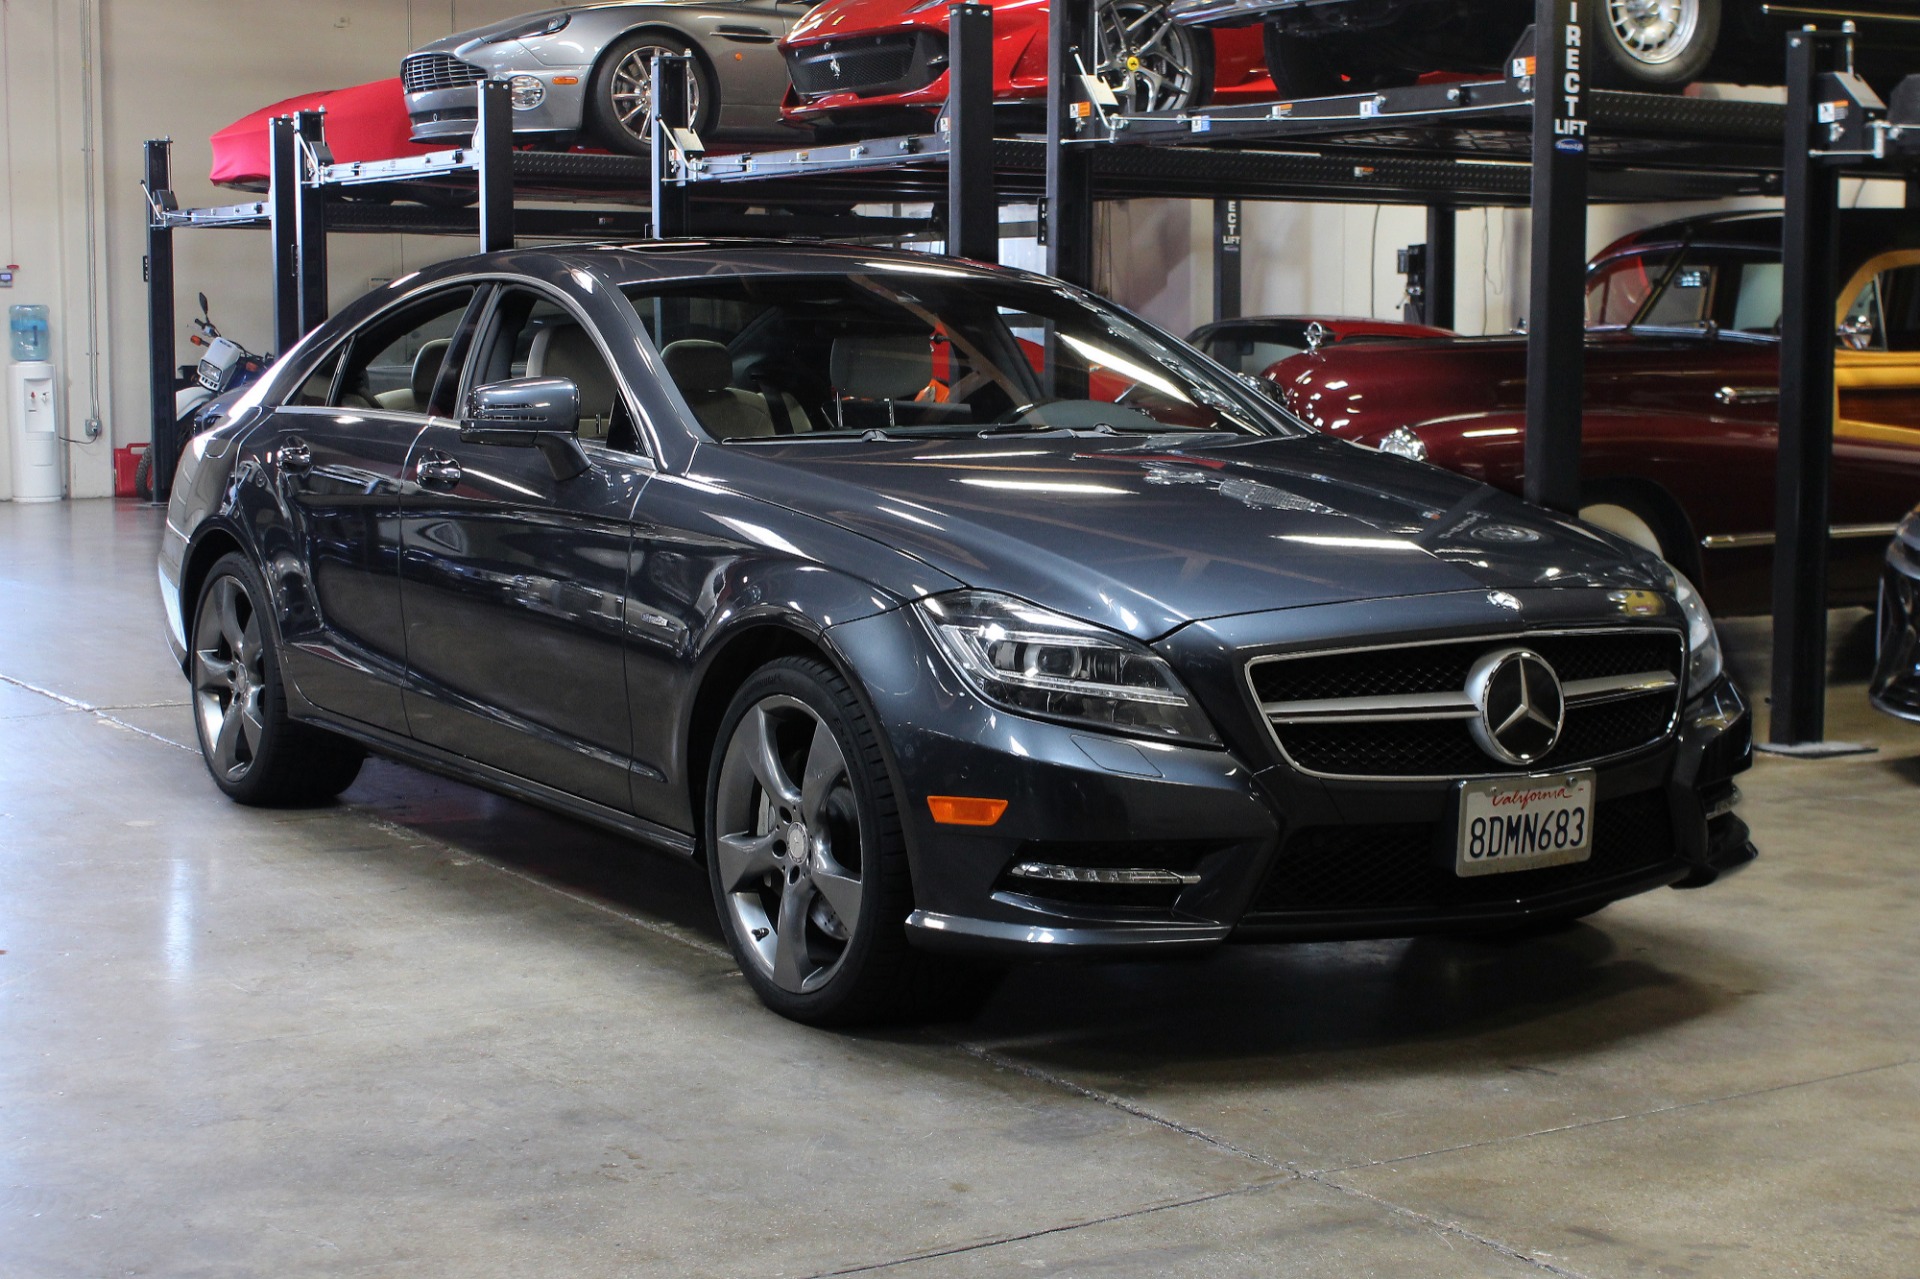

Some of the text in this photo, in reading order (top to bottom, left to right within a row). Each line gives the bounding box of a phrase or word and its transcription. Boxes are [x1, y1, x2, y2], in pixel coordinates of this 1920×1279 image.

[1554, 118, 1588, 136] LIFT
[1222, 235, 1241, 245] LIFT
[1492, 787, 1572, 810] California
[1469, 806, 1585, 858] 8DMN683
